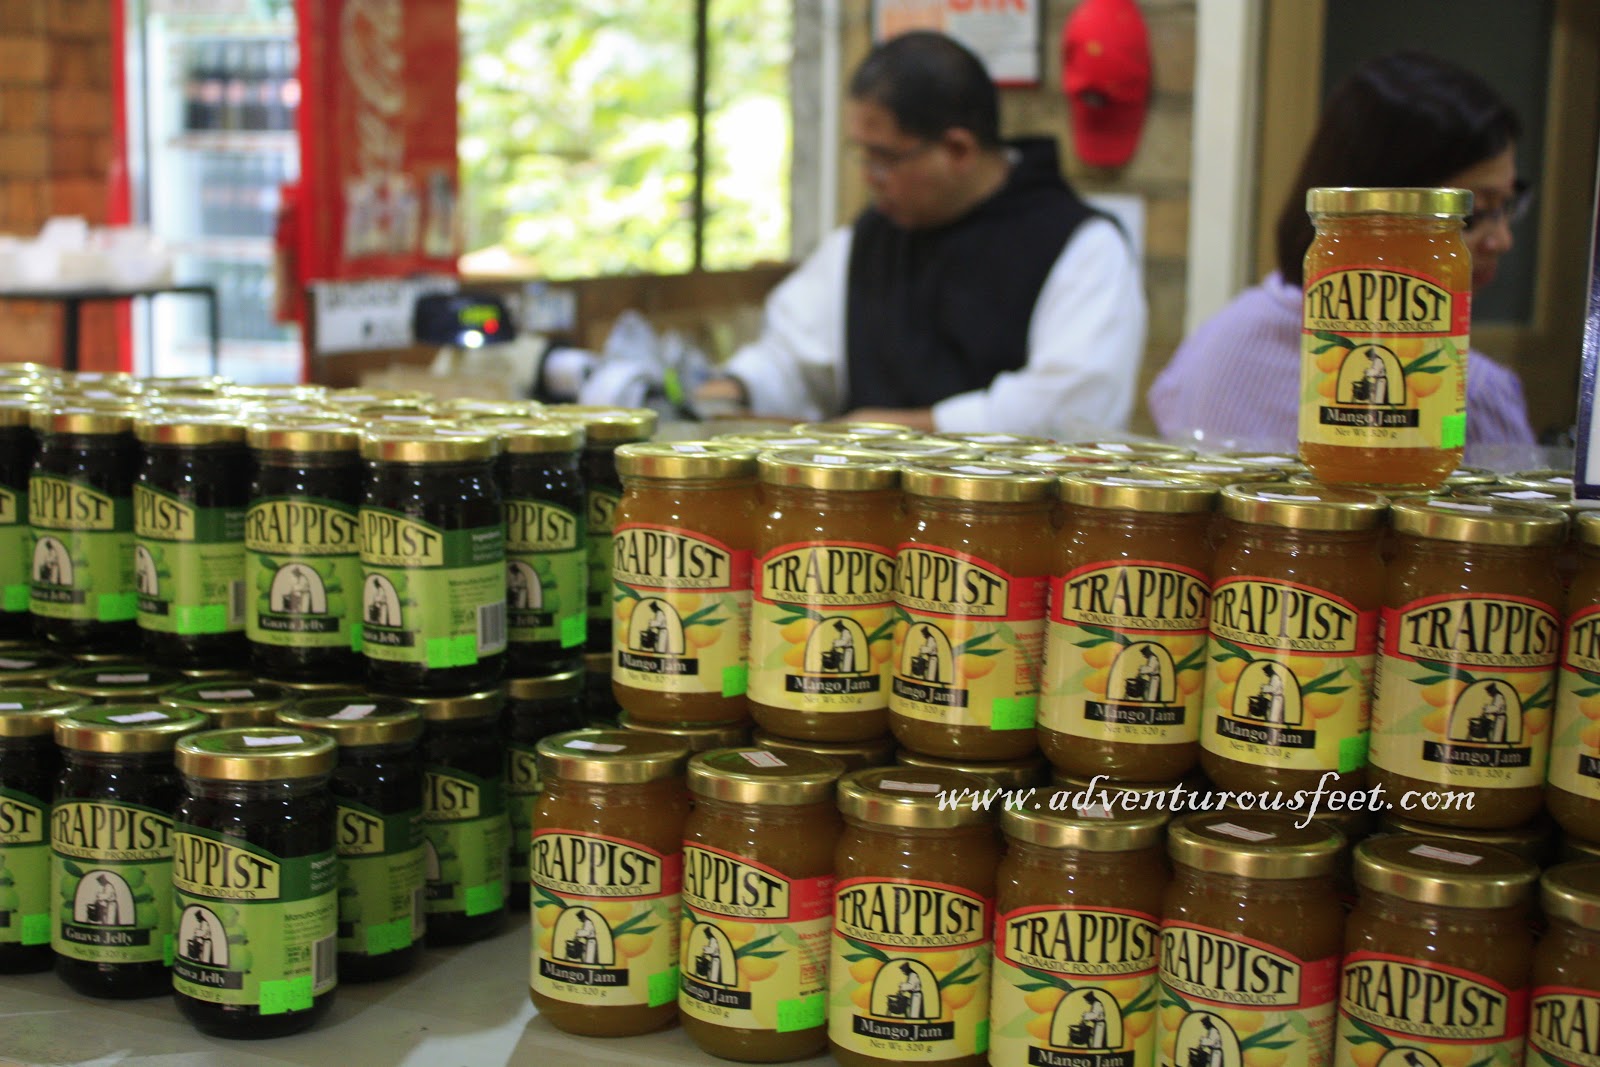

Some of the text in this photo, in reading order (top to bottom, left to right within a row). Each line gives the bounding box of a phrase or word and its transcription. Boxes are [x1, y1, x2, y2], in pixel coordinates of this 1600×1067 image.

[1307, 273, 1447, 322] TRAPPIST
[1387, 321, 1435, 331] PRODUCTS
[1327, 408, 1407, 427] Mango Jam
[614, 531, 725, 578] RAPPIST
[767, 547, 896, 594] TRAPPIST
[1070, 568, 1211, 619] TRAPPIST
[1213, 584, 1352, 640] TRAPPIST
[1131, 618, 1159, 628] FOOD
[1406, 601, 1559, 654] TRAPPIST
[1253, 635, 1282, 649] FOOD
[794, 677, 870, 693] Mango Jam
[926, 688, 955, 703] Jam
[1095, 704, 1176, 725] Mango Jam
[1222, 719, 1303, 746] Mango Jam
[1434, 745, 1522, 767] Mango Jam
[175, 835, 273, 889] APPIST
[566, 884, 592, 894] FOOD
[596, 886, 643, 895] PRODUCTS
[719, 904, 767, 917] PRODUCTS
[839, 885, 980, 936] TRAPPIST
[66, 928, 132, 945] Guava Jelly
[889, 935, 918, 945] FOOD
[922, 934, 969, 945] PRODUCTS
[1010, 912, 1160, 964] TRAPPIST
[545, 962, 616, 984] Mango Jam
[1020, 955, 1068, 972] MONASTIC
[1072, 962, 1103, 974] FOOD
[1163, 931, 1294, 994] RAPPIST
[199, 970, 225, 987] Jelly
[709, 989, 739, 1004] Jam
[1192, 984, 1219, 999] FOOD
[1223, 990, 1277, 1004] PRODUCTS
[1345, 964, 1502, 1027] TRAPPIST
[860, 1019, 943, 1041] Mango Jam
[1038, 1050, 1092, 1067] Mango
